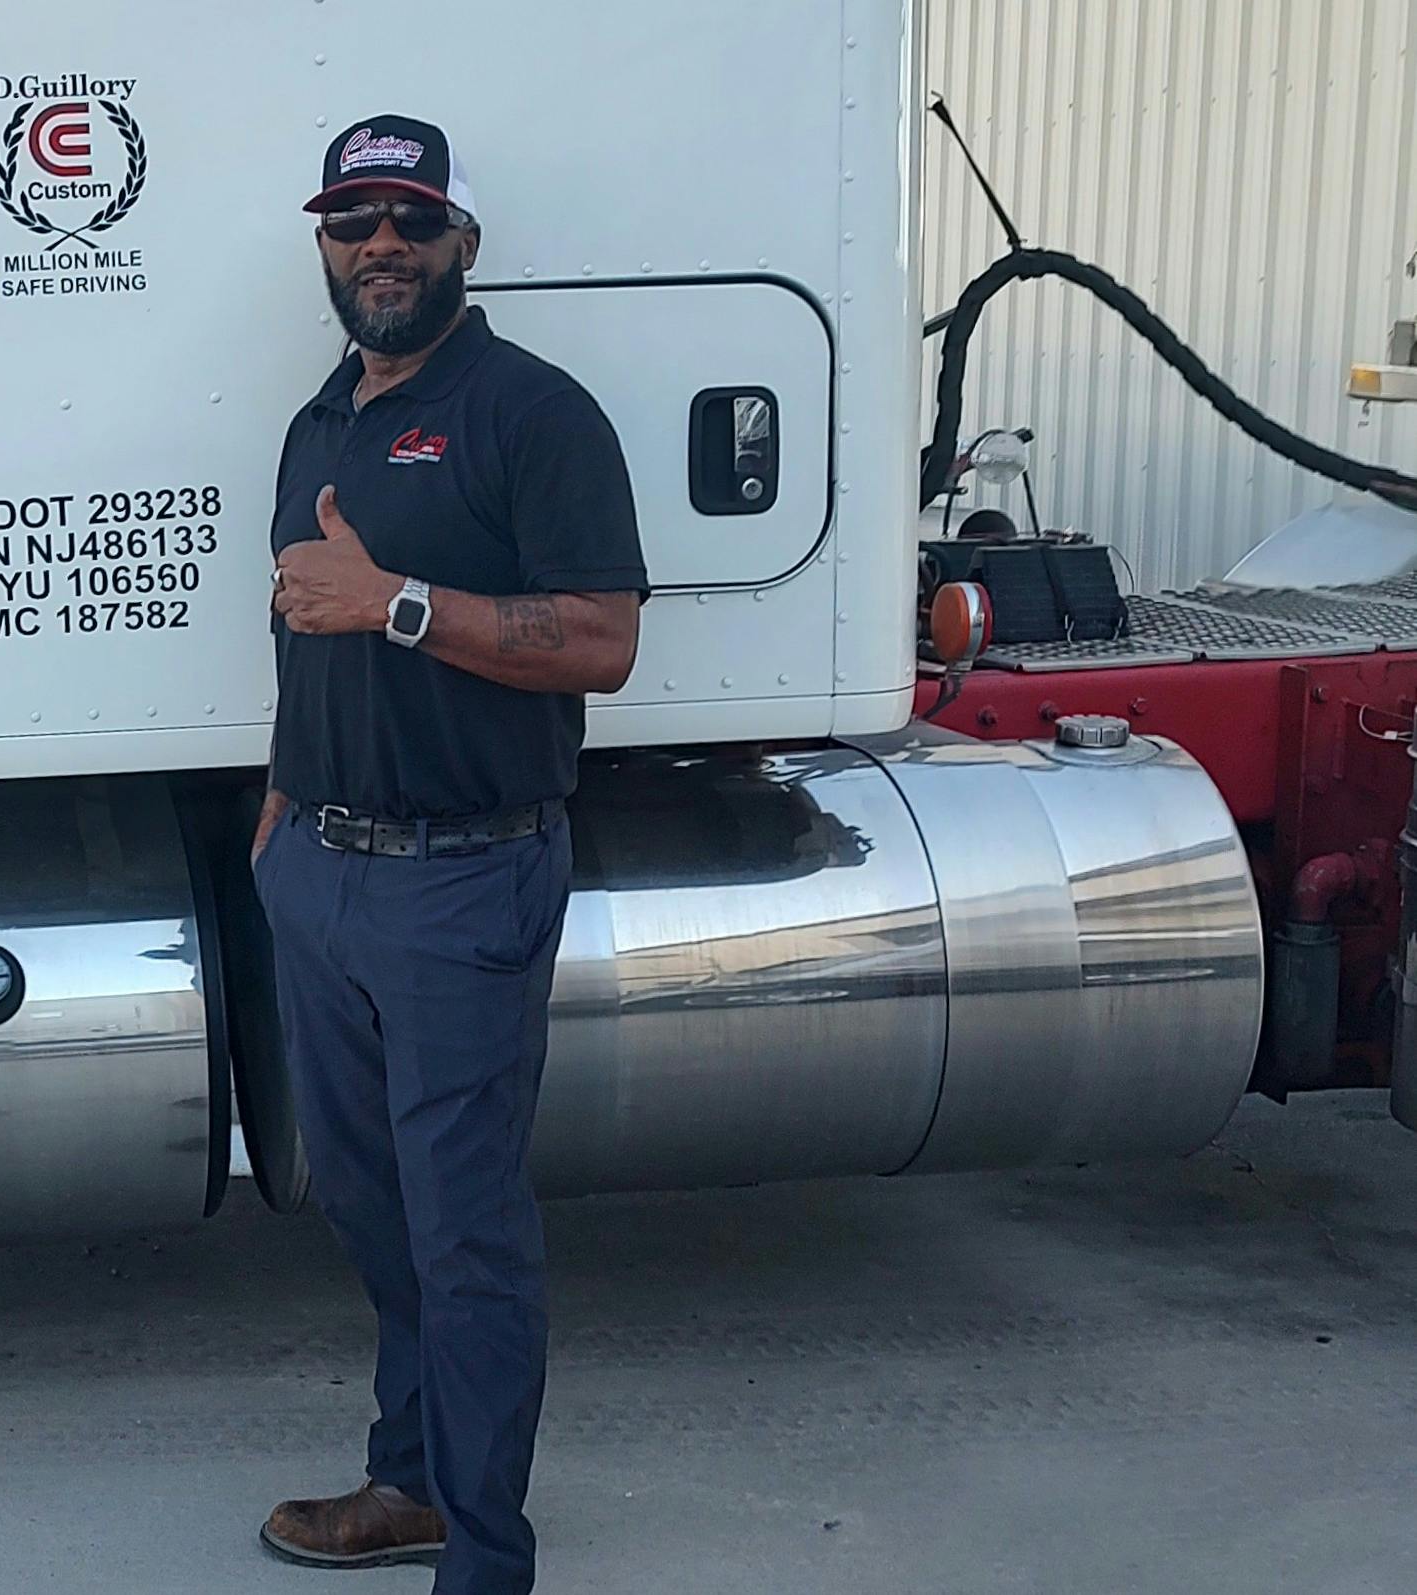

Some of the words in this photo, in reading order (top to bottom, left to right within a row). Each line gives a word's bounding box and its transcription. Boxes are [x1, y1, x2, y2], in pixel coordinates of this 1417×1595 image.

[27, 181, 112, 201] Custom
[4, 251, 88, 273] MILLION
[94, 249, 142, 269] MILE
[1, 278, 55, 297] SAFE
[60, 274, 147, 294] DRIVING
[88, 485, 222, 525] 293238
[26, 524, 218, 565] NJ486133
[67, 562, 200, 597] 106560
[56, 600, 189, 634] 187582
